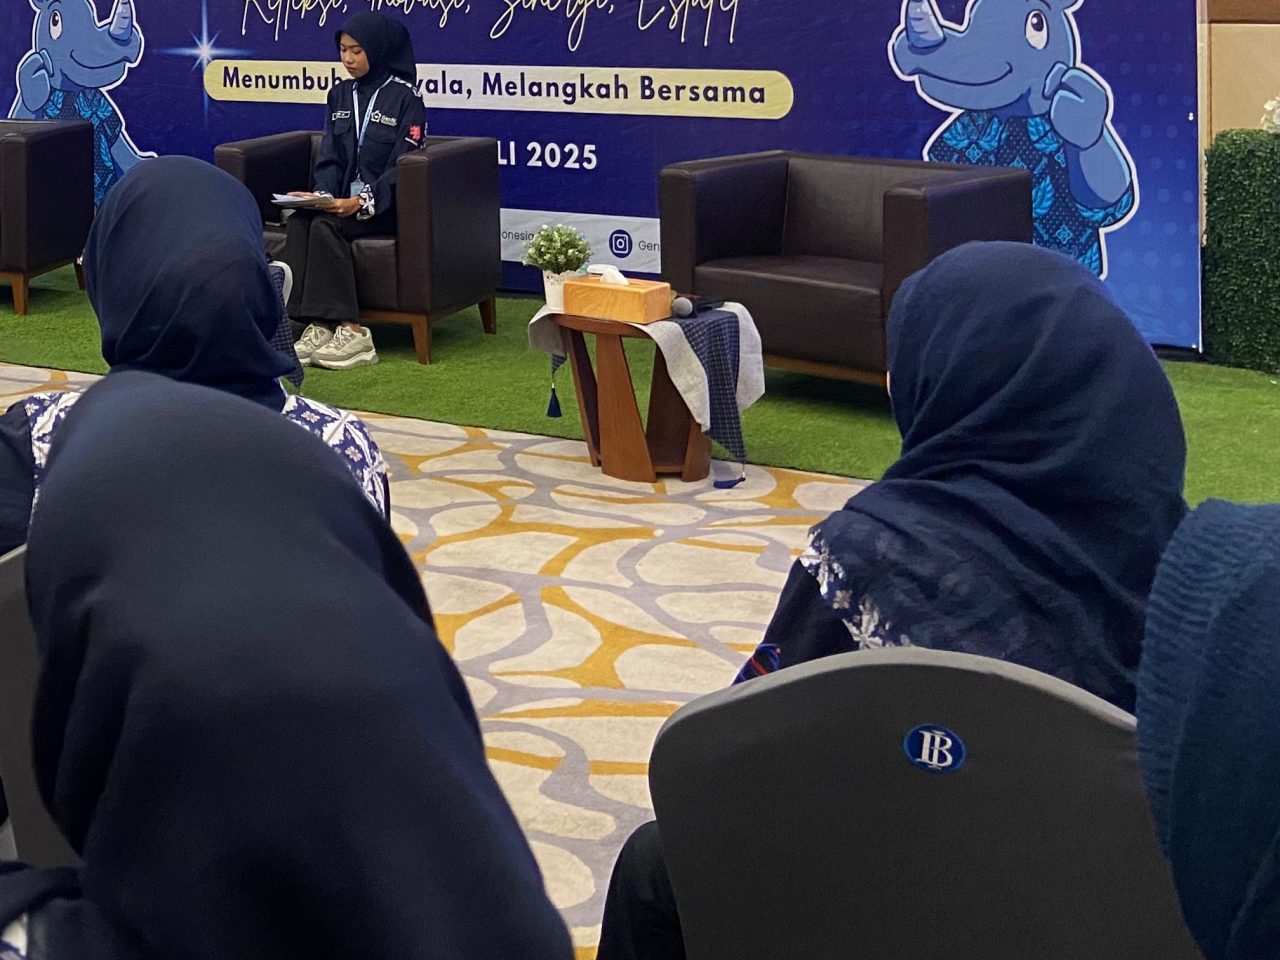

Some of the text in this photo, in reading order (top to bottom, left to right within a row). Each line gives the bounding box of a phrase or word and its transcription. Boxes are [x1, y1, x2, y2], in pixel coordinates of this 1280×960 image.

[482, 72, 629, 105] Melangkah
[640, 75, 766, 104] Bersama
[497, 140, 598, 170] LI 2025
[501, 230, 535, 242] onesia
[638, 240, 660, 252] Gen
